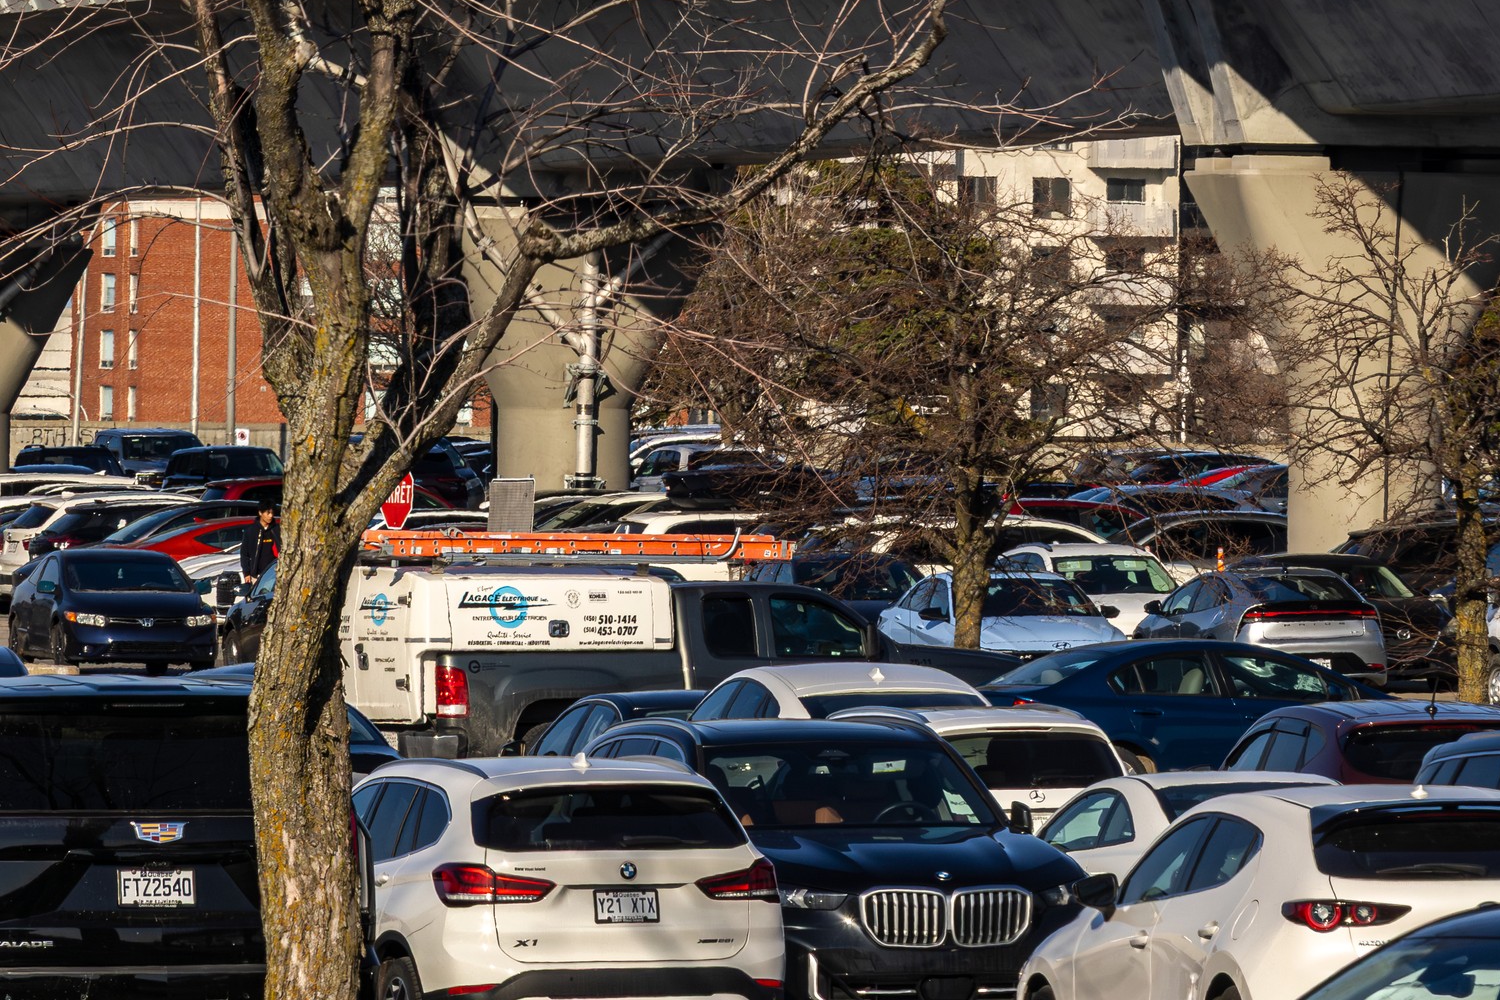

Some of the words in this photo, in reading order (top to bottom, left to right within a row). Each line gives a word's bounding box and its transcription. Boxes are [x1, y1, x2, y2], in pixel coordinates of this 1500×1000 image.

[458, 592, 501, 608] LAGACÉ
[598, 614, 637, 625] 510-1414
[597, 625, 639, 636] 453-0707
[122, 877, 192, 897] FTZ2540
[598, 897, 622, 914] Y21
[631, 897, 656, 914] XTX
[0, 940, 54, 948] ALADE
[513, 939, 538, 948] X1
